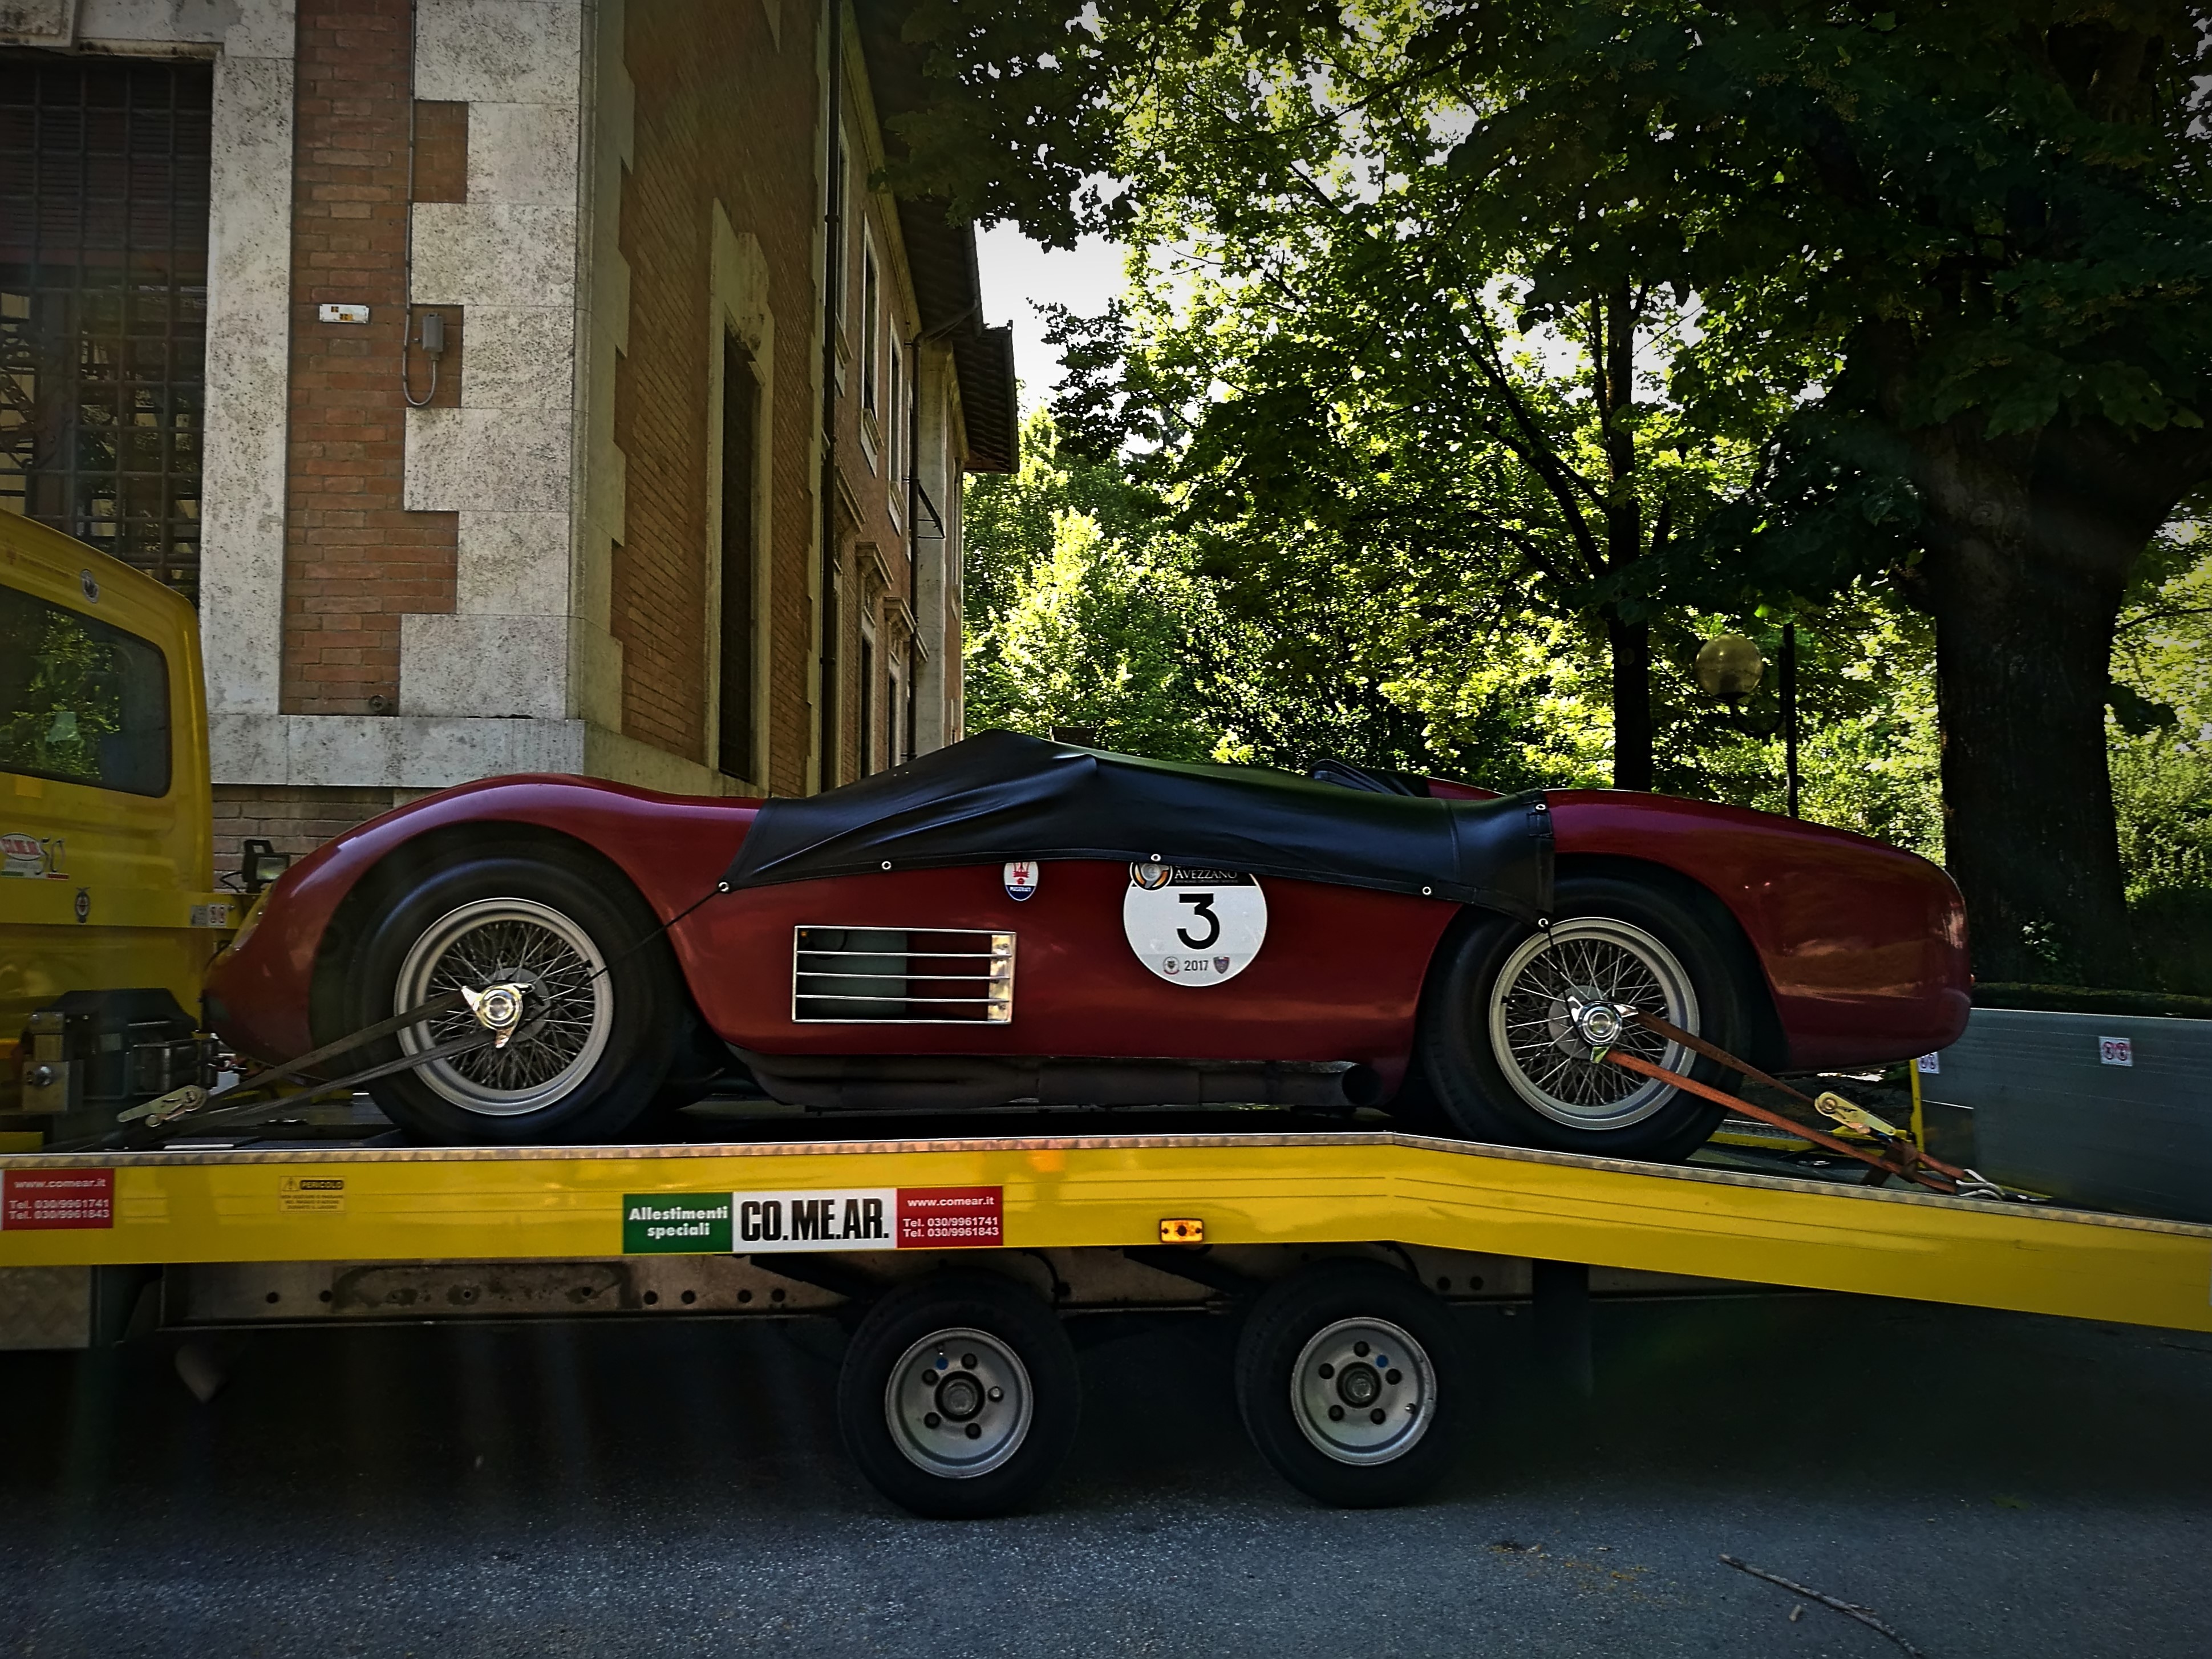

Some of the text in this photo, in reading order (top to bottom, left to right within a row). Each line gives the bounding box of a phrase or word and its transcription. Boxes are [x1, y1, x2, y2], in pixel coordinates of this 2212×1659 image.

[1174, 869, 1237, 879] AVEZZANO
[1177, 893, 1220, 950] 3
[1184, 960, 1209, 971] 2017
[14, 1178, 106, 1188] www.comear.it
[9, 1200, 32, 1209] Tel.
[907, 1196, 994, 1207] www.comear.it
[9, 1210, 32, 1219] Tel.
[629, 1206, 728, 1220] Allestimenti
[741, 1197, 889, 1241] CO.ME.AR.
[903, 1217, 998, 1227] Tel. 030/9961741
[647, 1223, 711, 1239] speciali
[927, 1227, 999, 1237] 030/9961843
